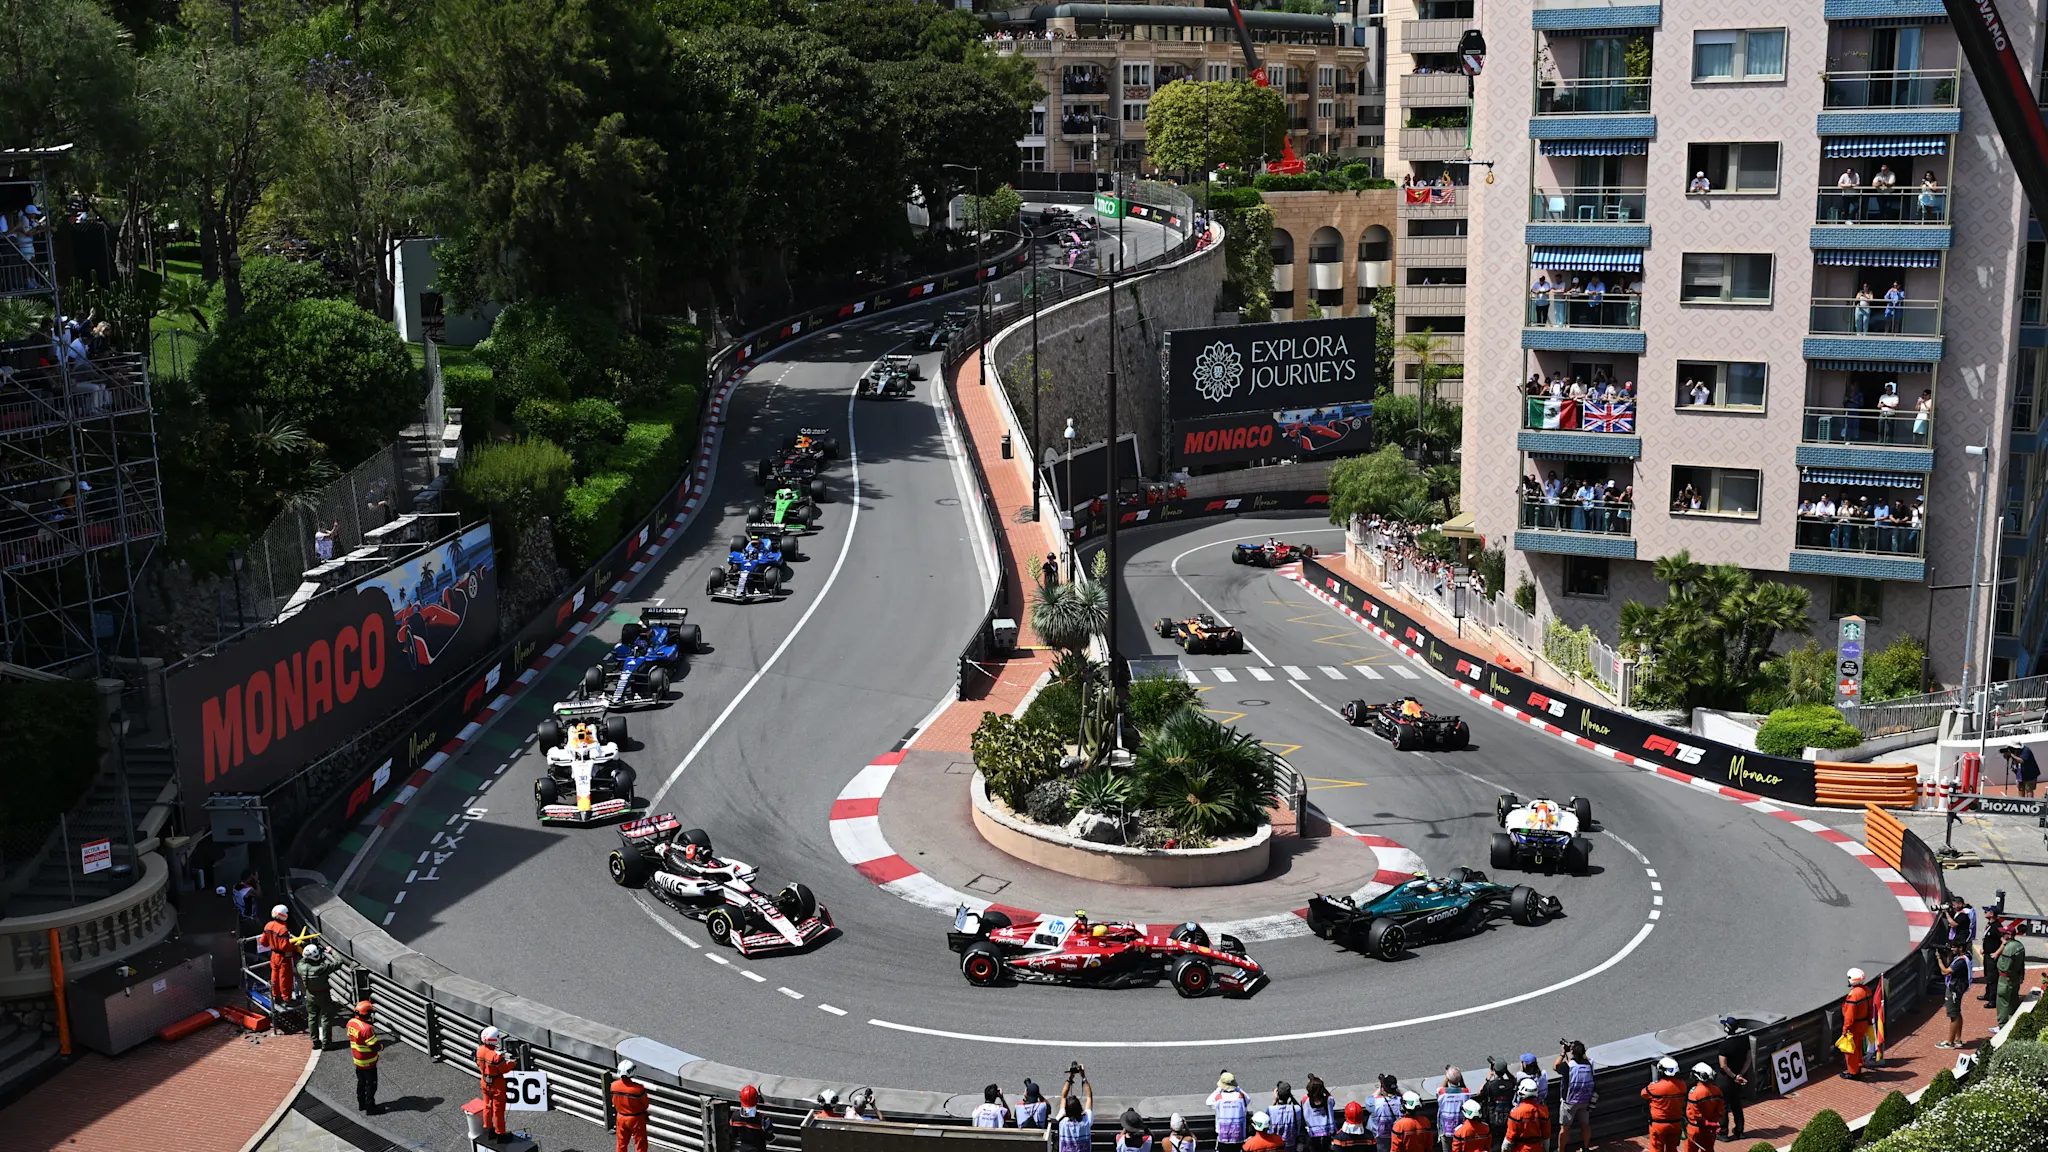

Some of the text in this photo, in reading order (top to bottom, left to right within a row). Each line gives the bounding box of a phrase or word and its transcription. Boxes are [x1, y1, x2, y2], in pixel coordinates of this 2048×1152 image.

[1251, 335, 1349, 363] EXPLORA
[1248, 359, 1356, 395] JOURNEYS
[1183, 424, 1273, 455] MONACO
[202, 612, 386, 787] MONACO
[1728, 754, 1783, 787] Monaco
[1981, 801, 2040, 814] PIOVANO
[1050, 921, 1065, 935] hp
[1427, 907, 1459, 924] aramco
[1081, 954, 1102, 968] 75
[1777, 1050, 1803, 1085] SC
[506, 1077, 541, 1105] SC
